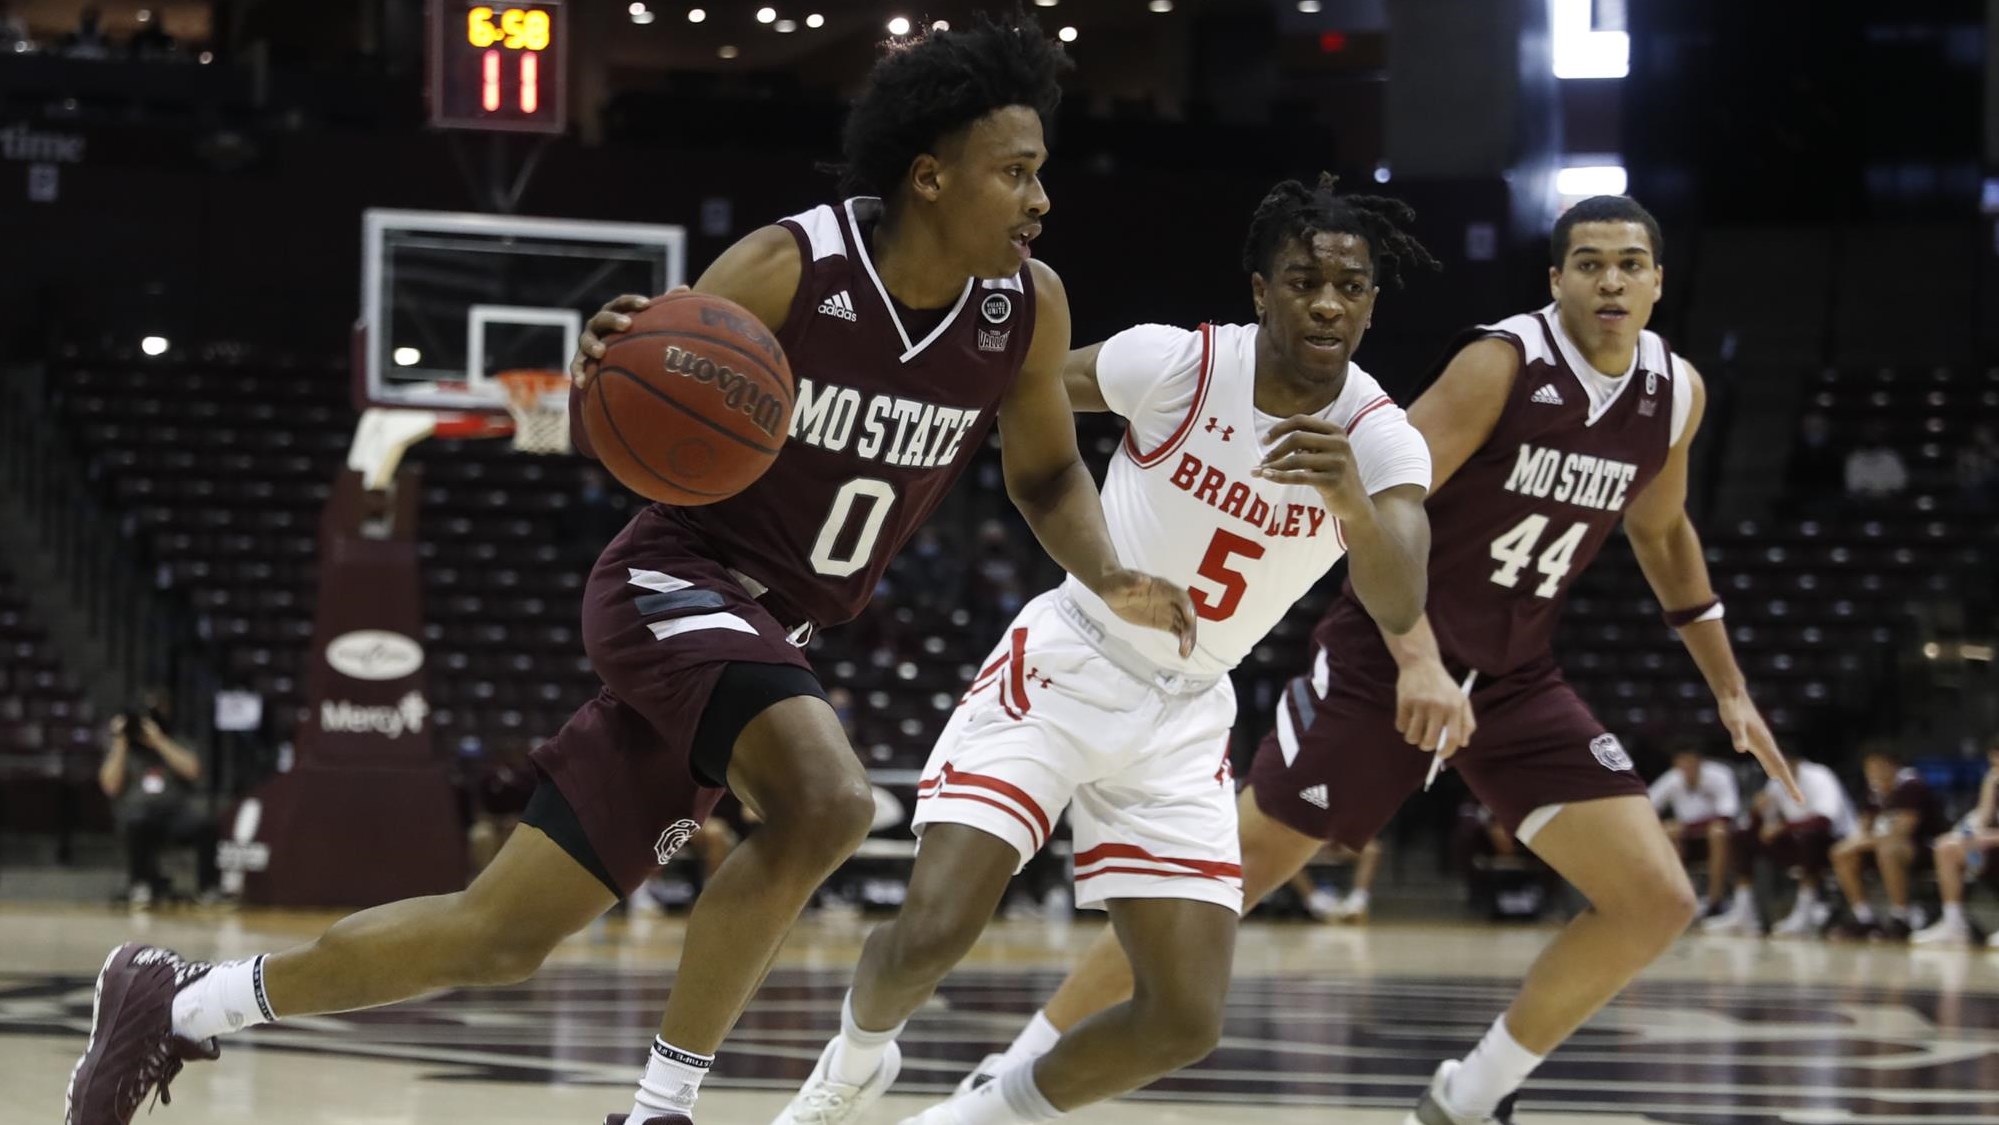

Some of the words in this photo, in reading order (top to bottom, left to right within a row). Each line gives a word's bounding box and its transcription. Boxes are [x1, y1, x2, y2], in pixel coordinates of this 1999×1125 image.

[482, 49, 538, 114] 11
[817, 303, 857, 322] adidas
[664, 345, 783, 439] Wilson
[787, 377, 862, 452] MO
[857, 394, 983, 468] STATE
[1169, 452, 1327, 538] BRADLEY
[1503, 443, 1562, 499] MO
[1553, 452, 1638, 512] STATE
[809, 477, 896, 578] 0
[1489, 512, 1590, 599] 44
[1186, 526, 1267, 623] 5
[320, 698, 404, 740] Mercy
